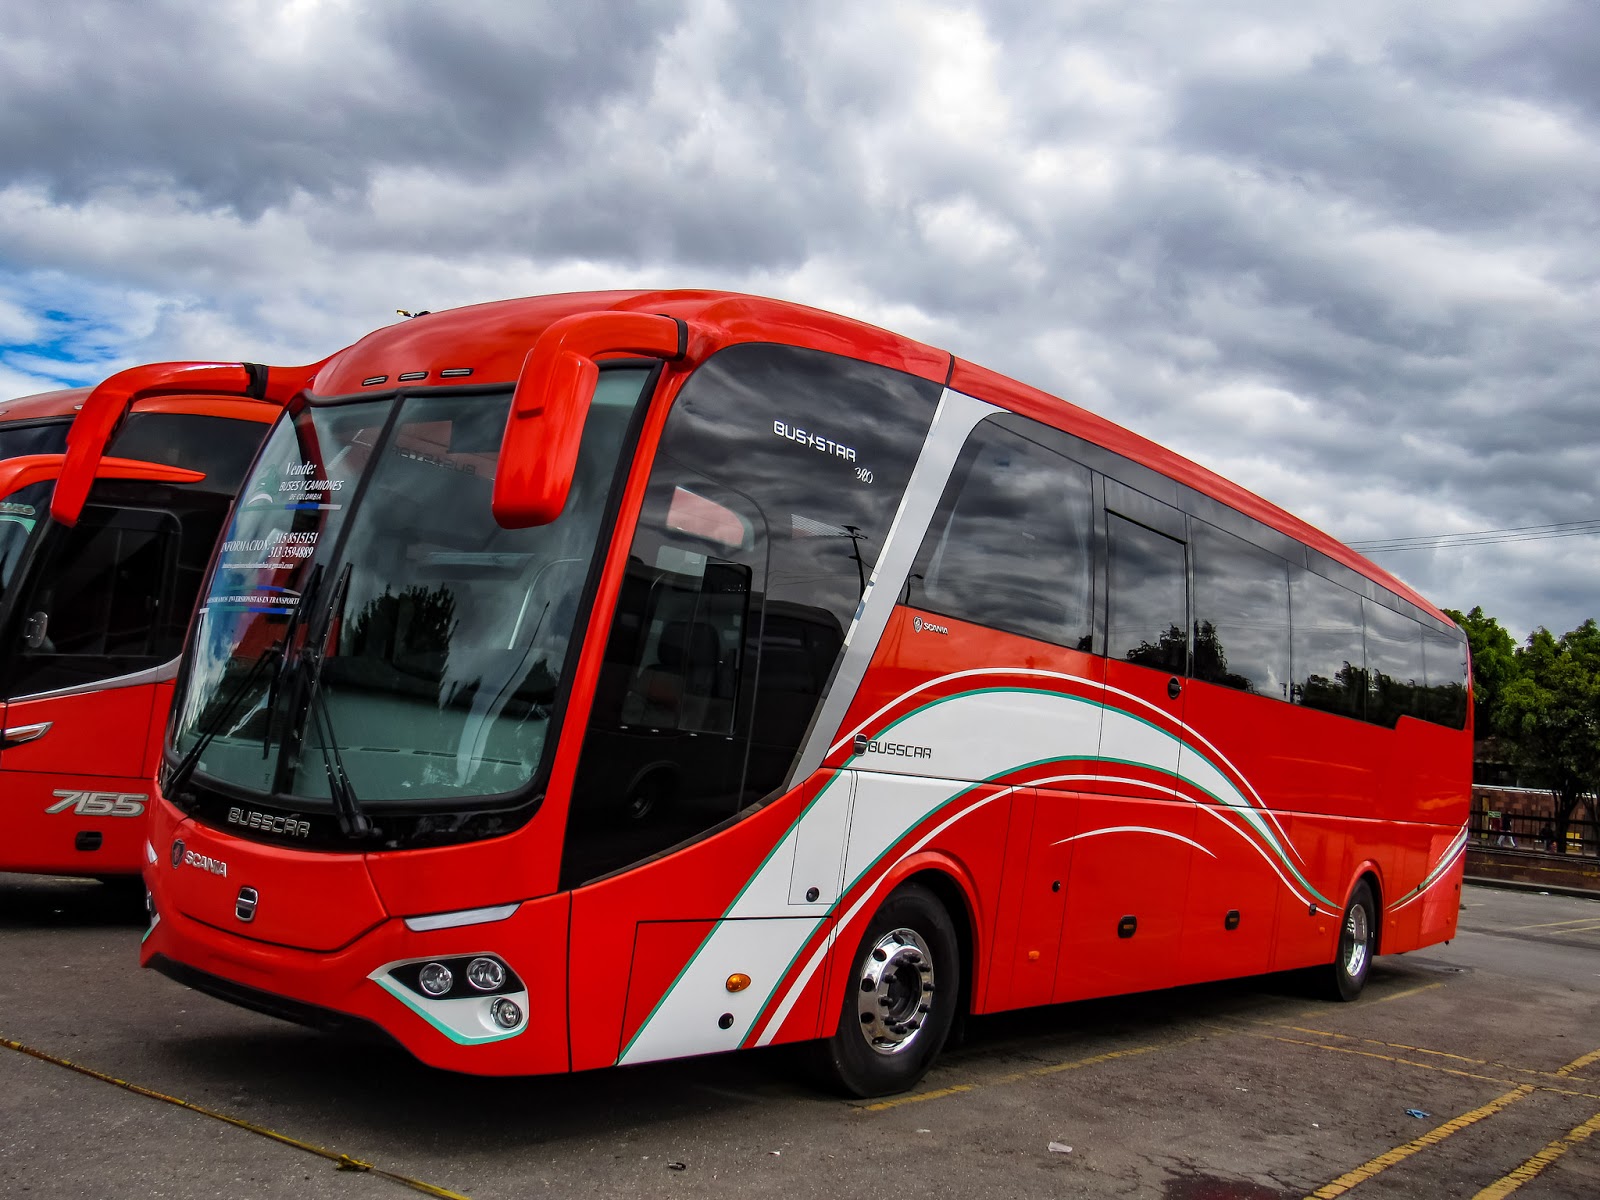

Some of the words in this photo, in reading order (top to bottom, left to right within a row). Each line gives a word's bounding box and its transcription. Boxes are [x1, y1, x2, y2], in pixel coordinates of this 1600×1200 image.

[286, 461, 317, 476] Vende:
[854, 467, 874, 484] 380
[279, 481, 301, 491] BUSES
[305, 480, 345, 491] CAMIONES
[287, 532, 319, 544] 8515151
[268, 547, 282, 558] 313
[923, 622, 949, 636] SCANIA
[868, 741, 932, 759] BUSSCAR
[44, 788, 149, 817] 7155
[228, 807, 311, 838] BUSSCAR
[184, 850, 227, 878] SCANIA
